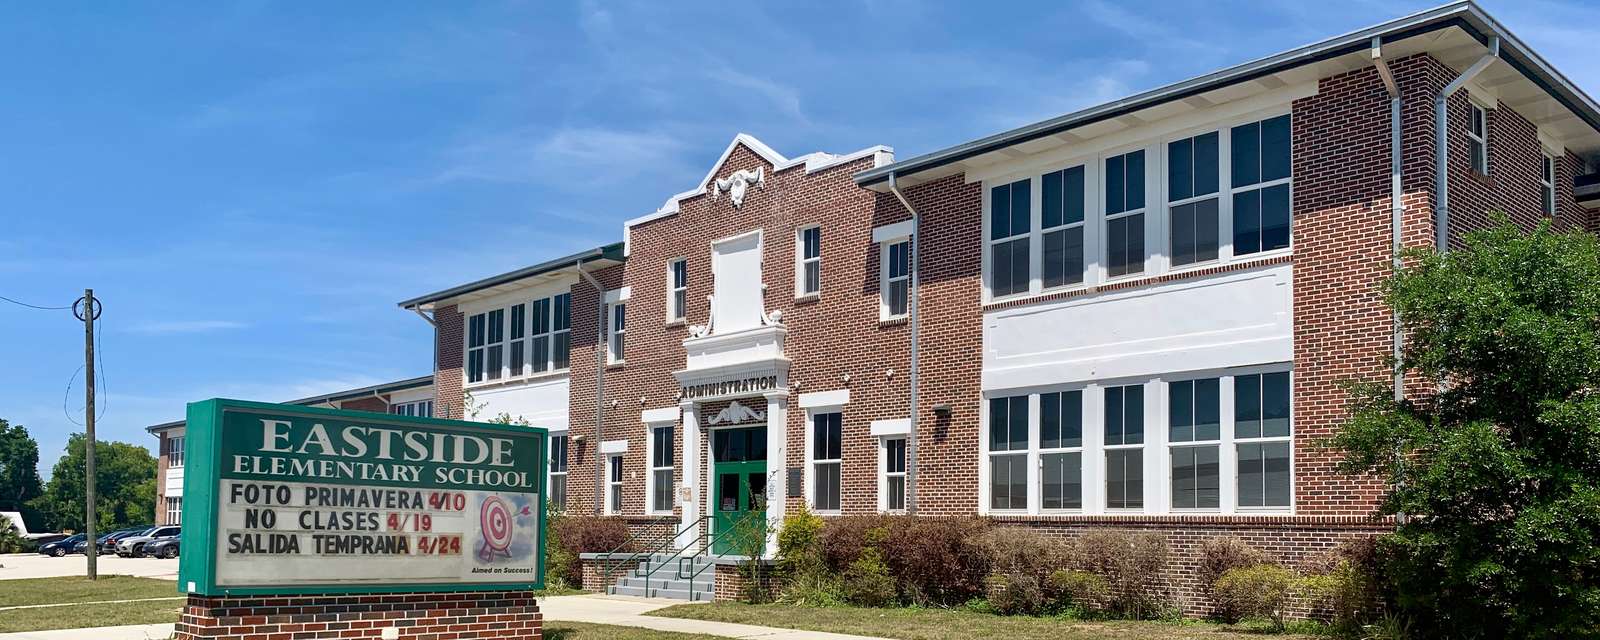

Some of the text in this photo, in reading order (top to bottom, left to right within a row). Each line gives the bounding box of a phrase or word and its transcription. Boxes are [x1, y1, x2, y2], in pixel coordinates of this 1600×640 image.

[681, 375, 777, 399] ADMINISTRATION
[257, 418, 515, 467] EASTSIDE
[232, 454, 532, 488] ELEMENTARY SCHOOL
[230, 483, 466, 511] FOTO PRIMAVERA 4/10
[245, 508, 432, 532] NO CLASES 4/19
[228, 533, 461, 555] SALIDA TEMPRANA 4/24
